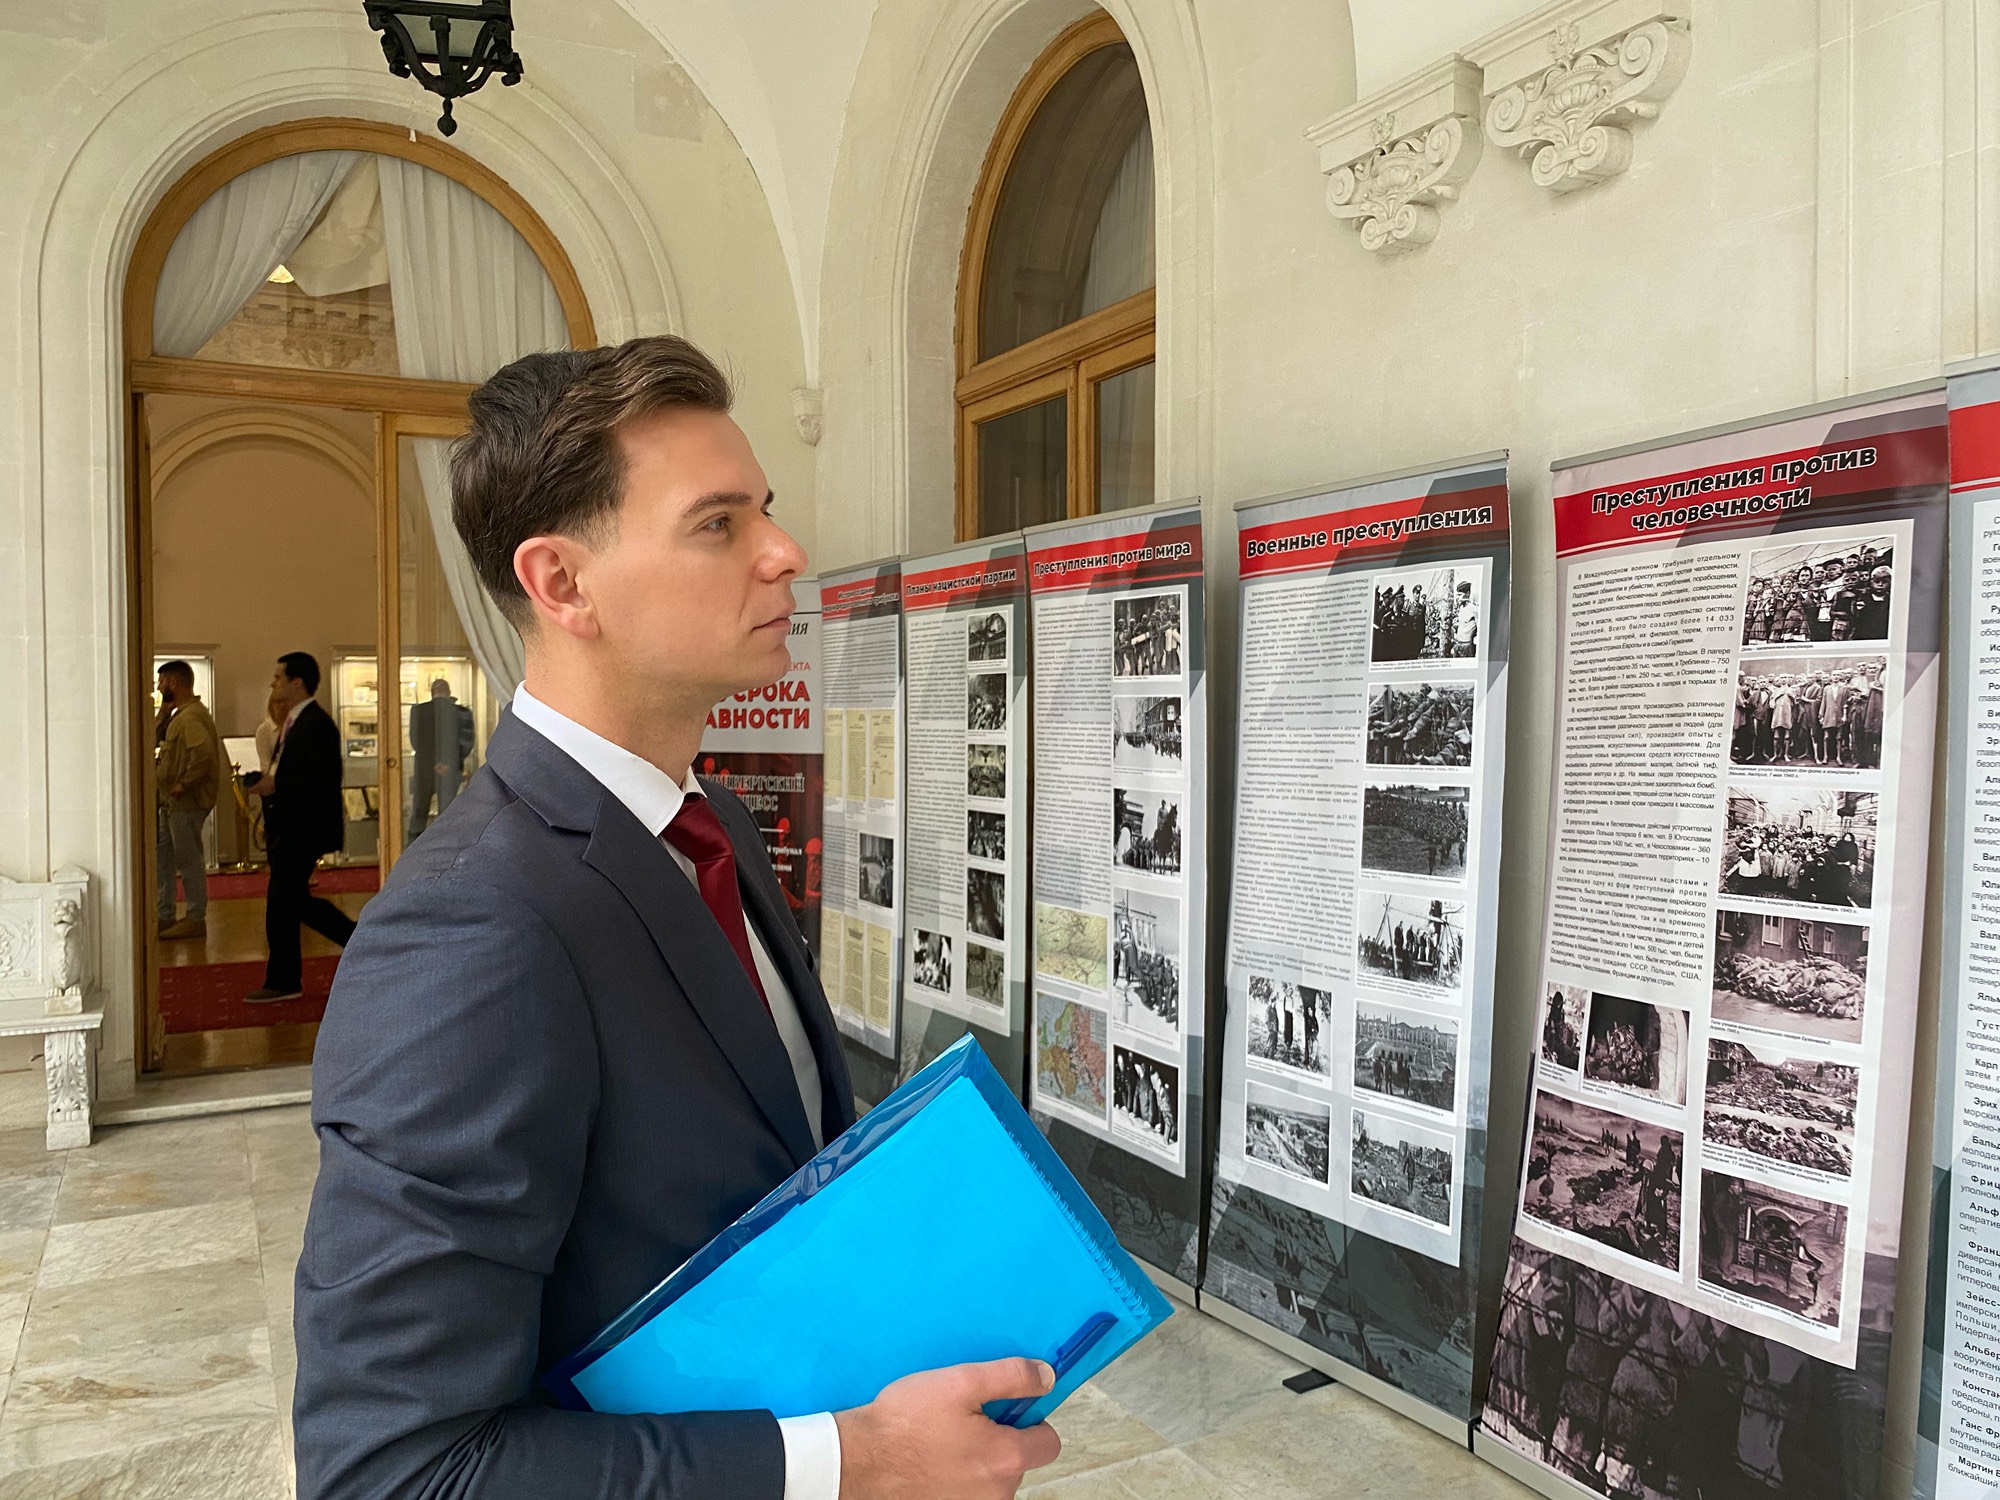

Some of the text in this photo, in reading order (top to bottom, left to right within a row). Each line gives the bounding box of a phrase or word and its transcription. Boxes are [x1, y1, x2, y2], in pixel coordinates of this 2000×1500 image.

[1592, 446, 1876, 514] Преступления против
[1631, 485, 1812, 531] человечности
[1247, 506, 1492, 558] Военные преступления
[1034, 542, 1191, 578] Преступления против мира
[1662, 557, 1694, 568] трибунале
[1697, 552, 1741, 563] отдельному
[906, 569, 1016, 597] Планы нацистской партии
[1693, 573, 1738, 583] порабощении,
[1692, 583, 1737, 592] совершенных
[1650, 620, 1678, 629] создано
[1680, 617, 1701, 625] более
[1681, 668, 1716, 676] Освенциме
[1708, 721, 1722, 729] (для
[1671, 824, 1712, 833] устроителей
[1674, 834, 1711, 843] Югославии
[1660, 877, 1698, 886] нацистами
[1679, 889, 1707, 897] против
[1669, 898, 1706, 908] еврейского
[1667, 909, 1706, 918] еврейского
[1669, 919, 1705, 929] временно
[1679, 930, 1699, 939] гетто,
[1683, 941, 1704, 949] детей
[1970, 942, 1996, 952] затем
[1648, 945, 1703, 960] 500 были
[1681, 971, 1701, 981] США,
[1975, 1058, 1998, 1070] Карл
[1965, 1069, 1991, 1080] затем
[1974, 1097, 1998, 1110] Эрих
[1962, 1157, 1992, 1170] партии
[1969, 1202, 2000, 1218] Альф
[1959, 1224, 1977, 1234] сил;
[1958, 1260, 1992, 1278] Первой
[1953, 1362, 1994, 1382] комитета
[1951, 1400, 1993, 1422] обороны,
[1960, 1417, 1982, 1432] Ганс
[1949, 1438, 1979, 1456] отдела
[1958, 1455, 1993, 1476] Мартин
[1948, 1463, 1998, 1488] ближайший
